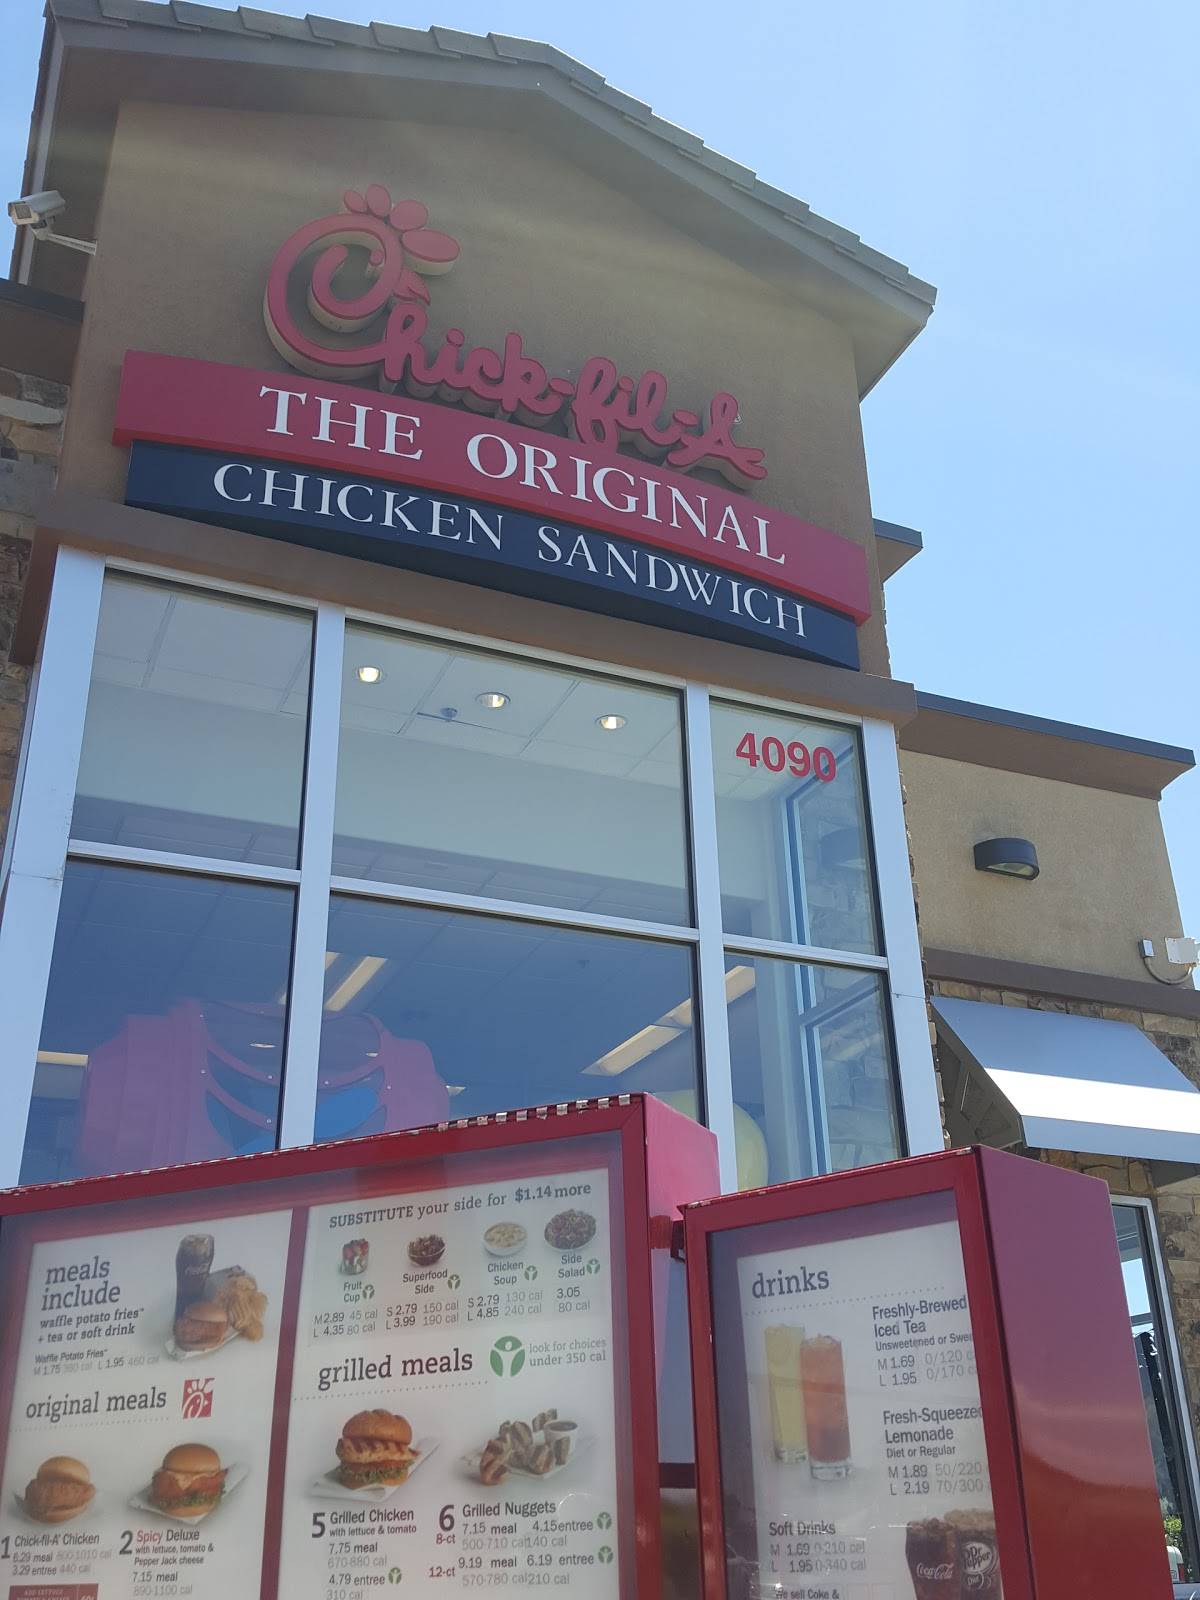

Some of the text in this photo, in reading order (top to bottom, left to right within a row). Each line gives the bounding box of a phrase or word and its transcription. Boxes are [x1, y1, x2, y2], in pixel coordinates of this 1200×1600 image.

[260, 385, 786, 565] THE ORIGINAL
[213, 463, 807, 638] CHICKEN SANDWICH
[736, 732, 837, 783] 4090
[330, 1185, 591, 1228] SUBSTITUTE your side for $1.14 more
[488, 1261, 524, 1273] Chicken
[561, 1254, 582, 1265] Side
[45, 1256, 110, 1284] meals
[403, 1269, 448, 1283] Superfood
[558, 1267, 585, 1278] Salad
[343, 1281, 362, 1291] Fruit
[494, 1275, 517, 1286] Soup
[752, 1266, 829, 1298] drinks
[41, 1281, 120, 1311] include
[415, 1284, 434, 1294] Side
[557, 1287, 580, 1299] 3.05
[343, 1293, 360, 1304] Cup
[477, 1294, 500, 1307] 2.79
[529, 1290, 543, 1301] cal
[575, 1300, 590, 1311] cal
[396, 1303, 417, 1315] 2.79
[445, 1300, 459, 1311] cal
[477, 1306, 499, 1319] 4.85
[528, 1304, 542, 1314] cal
[872, 1295, 967, 1320] Freshly-Brewed
[40, 1311, 110, 1328] waffle potato
[324, 1312, 344, 1323] 2.89
[365, 1309, 378, 1319] cal
[394, 1315, 415, 1328] 3.99
[445, 1312, 459, 1323] cal
[47, 1323, 135, 1342] tea or soft drink
[323, 1322, 376, 1336] 4.35 cal
[874, 1320, 926, 1338] Iced Tea
[529, 1339, 607, 1353] look for choices
[876, 1336, 947, 1351] Unsweetened or
[105, 1357, 124, 1369] 1.95
[529, 1350, 606, 1367] under 350 cal
[878, 1359, 887, 1370] M
[890, 1355, 915, 1368] 1.69
[318, 1348, 473, 1391] grilled meals
[879, 1375, 887, 1386] L
[892, 1372, 917, 1386] 1.95
[26, 1387, 167, 1423] original meals
[885, 1425, 954, 1444] Lemonade
[886, 1445, 956, 1458] Diet or Regular
[888, 1466, 898, 1478] M
[902, 1464, 928, 1478] 1.89
[890, 1483, 897, 1496] L
[903, 1481, 930, 1495] 2.19
[312, 1508, 414, 1538] 5 Grilled Chicken
[439, 1501, 556, 1532] 6 Grilled Nuggets
[329, 1524, 416, 1537] with lettuce & tomato
[462, 1519, 593, 1535] 7.15 meal 4.15 entree
[769, 1520, 835, 1536] Soft Drinks
[1, 1536, 10, 1559] 1
[63, 1532, 100, 1545] Chicken
[119, 1529, 200, 1555] 2 Spicy Deluxe
[436, 1533, 567, 1547] 8-ct cal
[180, 1544, 205, 1553] tomato
[329, 1542, 378, 1554] 7.75 meal
[33, 1552, 53, 1562] meal
[134, 1555, 204, 1567] Pepper Jack cheese
[373, 1554, 387, 1567] cal
[458, 1554, 594, 1569] 9.19 meal 6.19 entree
[32, 1566, 56, 1575] entree
[790, 1560, 813, 1573] 1.95
[850, 1558, 866, 1570] cal
[156, 1571, 178, 1582] meal
[329, 1573, 385, 1586] 4.79 entree
[429, 1566, 455, 1578] 12-ct
[554, 1573, 570, 1584] cal
[808, 1588, 829, 1600] Coke
